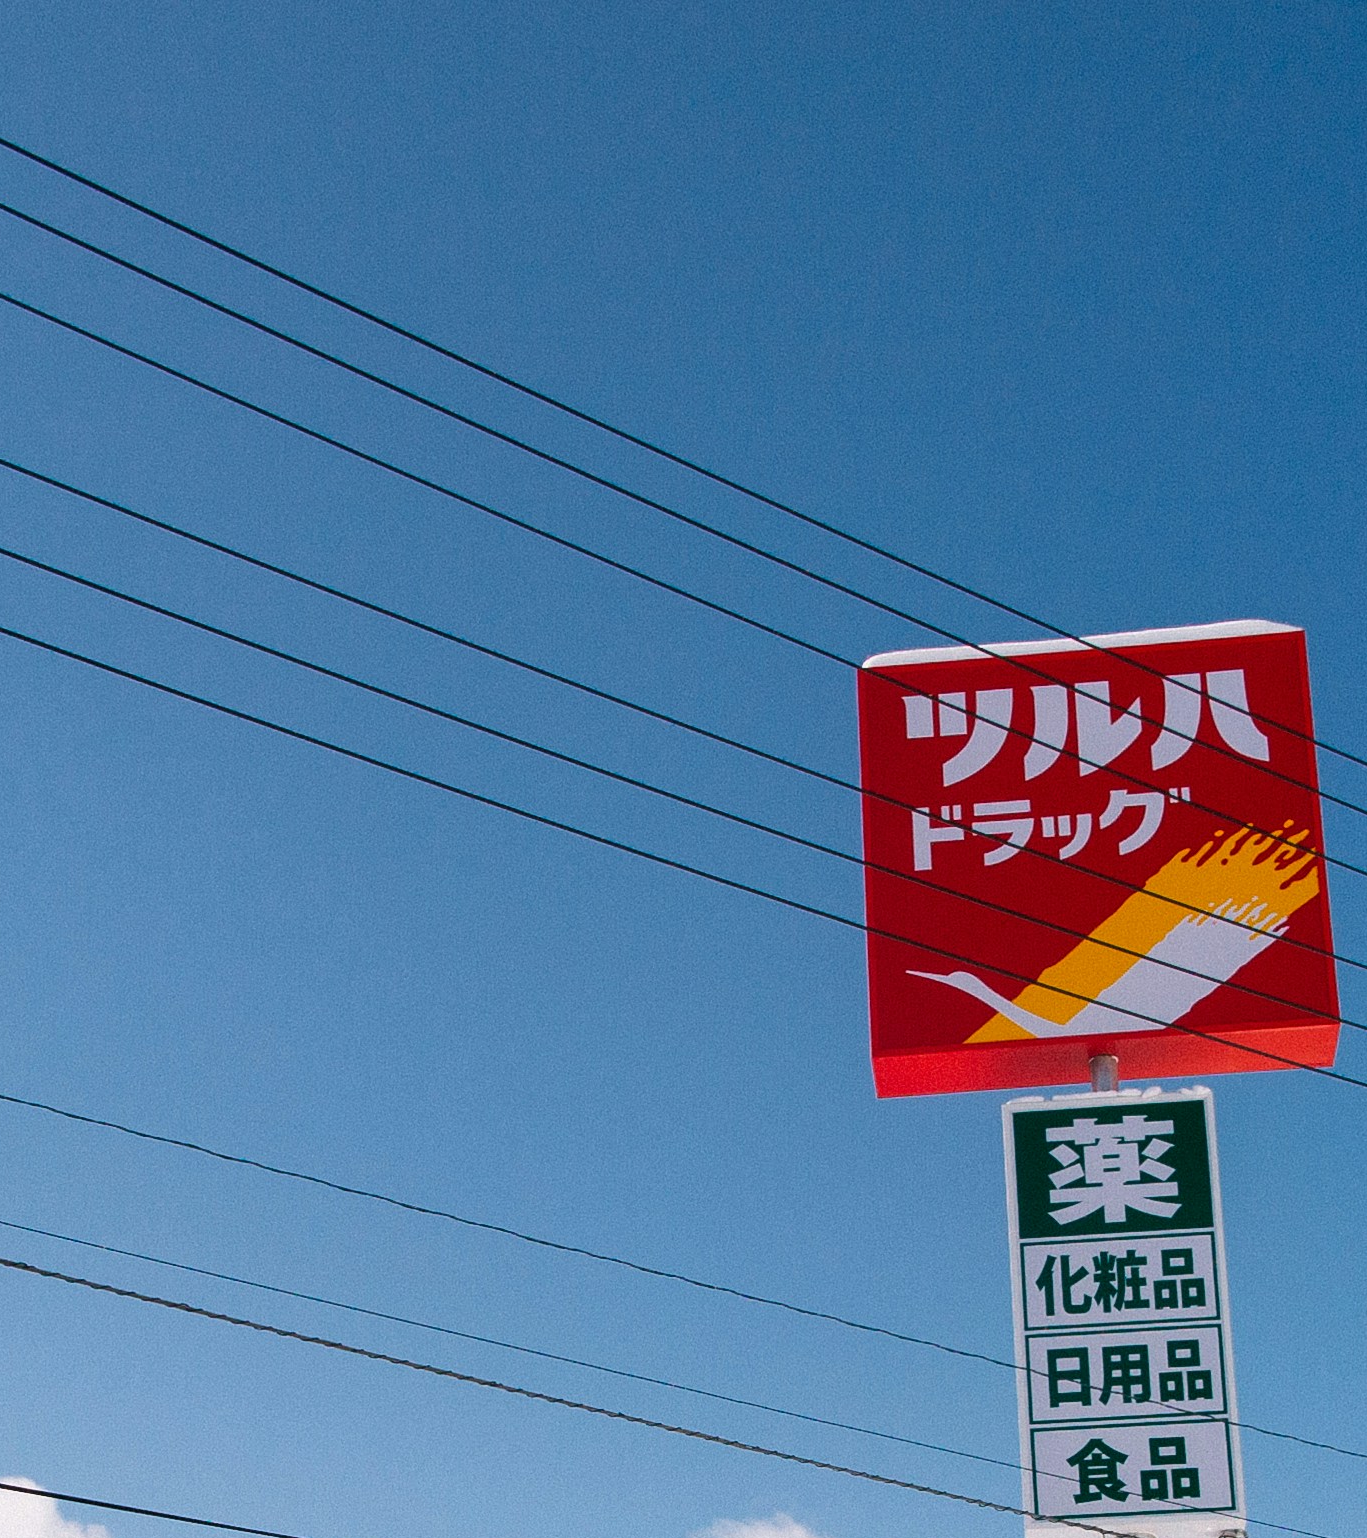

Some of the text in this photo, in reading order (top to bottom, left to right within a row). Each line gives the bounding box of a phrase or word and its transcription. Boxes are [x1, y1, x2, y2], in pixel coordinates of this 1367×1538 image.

[902, 669, 1269, 787] ツルハ
[912, 787, 1191, 872] ドラッグ
[1045, 1115, 1182, 1225] 薬
[1036, 1247, 1206, 1318] 化粧品
[1047, 1338, 1214, 1408] 日用品
[1066, 1436, 1201, 1507] 食品
